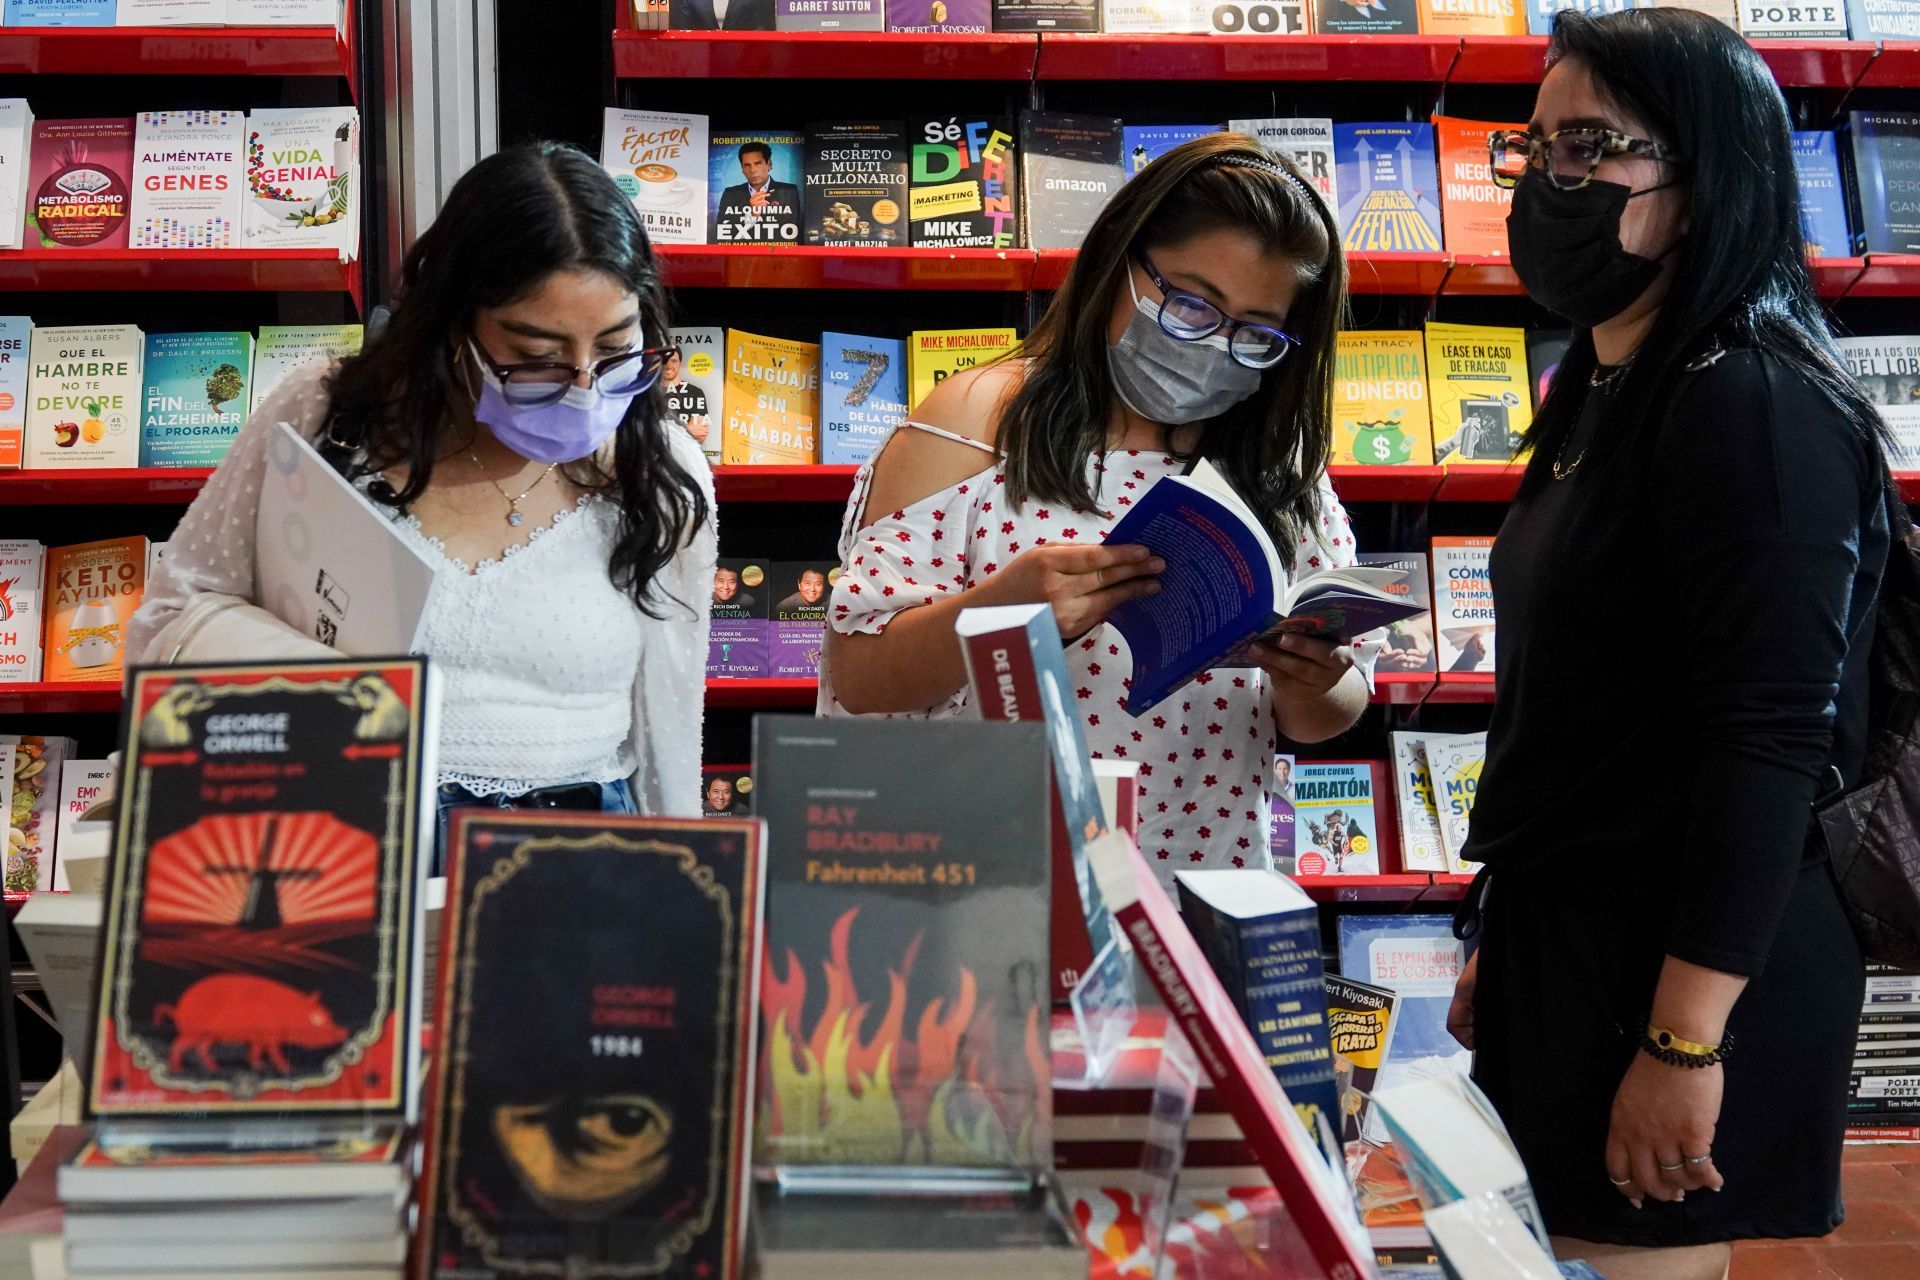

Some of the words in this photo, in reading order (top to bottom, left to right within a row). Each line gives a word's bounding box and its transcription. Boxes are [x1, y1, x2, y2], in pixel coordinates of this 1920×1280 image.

[789, 1, 828, 12] GARRET
[831, 0, 871, 11] SUTTON
[1432, 0, 1514, 17] VENTAS
[1750, 7, 1836, 23] PORTE
[891, 25, 929, 33] ROBERT
[942, 25, 986, 33] KIYOSAKI
[1864, 117, 1908, 125] MICHAEL
[625, 125, 638, 133] EL
[924, 116, 961, 143] Sé
[1257, 126, 1289, 136] VÍCTOR
[1290, 127, 1327, 136] GORDOA
[146, 134, 198, 142] ALEJANDRA
[201, 133, 232, 141] PONCE
[285, 139, 311, 148] UNA
[621, 126, 690, 151] FACTOR
[713, 137, 751, 145] ROBERTO
[142, 149, 233, 163] ALIMÉNTATE
[272, 149, 323, 166] VIDA
[629, 143, 681, 165] LATTE
[820, 149, 892, 161] SECRETO
[167, 163, 191, 171] SEGÚN
[261, 165, 340, 184] GENIAL
[831, 161, 882, 173] MULTI
[144, 174, 229, 192] GENES
[806, 173, 907, 185] MILLONARIO
[1045, 178, 1107, 193] amazon
[38, 194, 123, 205] METABOLISMO
[1361, 197, 1416, 210] LIDERAZGO
[38, 204, 124, 219] RADICAL
[725, 205, 792, 216] ALQUIMIA
[659, 215, 692, 228] BACH
[740, 215, 763, 223] PARA
[716, 217, 799, 240] ÉXITO
[923, 221, 972, 236] MIKE
[1344, 211, 1441, 251] EFECTIVO
[913, 235, 994, 249] MICHALOWICZ
[47, 335, 79, 343] SUSAN
[83, 334, 120, 342] ALBERS
[920, 336, 944, 349] MIKE
[946, 334, 1010, 348] MICHALOWICZ
[1373, 340, 1414, 348] TRACY
[59, 350, 86, 358] QUE
[92, 349, 106, 357] EL
[1441, 343, 1471, 358] LÉASE
[1472, 345, 1485, 358] EN
[1487, 346, 1512, 359] CASO
[1844, 347, 1871, 359] MIRA
[1874, 347, 1881, 358] A
[1884, 347, 1903, 357] LOS
[956, 357, 976, 367] UN
[1450, 360, 1462, 373] DE
[1464, 360, 1507, 374] FRACASO
[1849, 358, 1877, 377] DEL
[36, 362, 128, 378] HAMBRE
[732, 359, 818, 391] LENGUAJE
[830, 371, 849, 381] LOS
[842, 349, 890, 406] 7
[61, 382, 79, 390] NO
[86, 381, 100, 389] TE
[148, 387, 162, 395] EL
[1346, 381, 1423, 401] DINERO
[36, 395, 123, 411] DEVORE
[147, 396, 182, 412] FIN
[184, 401, 207, 411] DEL
[667, 397, 705, 410] QUE
[757, 395, 788, 413] SIN
[146, 412, 241, 427] ALZHEIMER
[849, 411, 864, 421] DE
[866, 413, 881, 423] LA
[145, 428, 161, 438] EL
[165, 426, 239, 438] PROGRAMA
[729, 417, 815, 451] PALABRAS
[75, 557, 111, 569] PODER
[56, 562, 137, 590] KETO
[55, 581, 136, 605] AYUNO
[1450, 591, 1466, 599] UN
[715, 610, 751, 618] VENTAJA
[780, 612, 789, 620] EL
[992, 648, 1011, 673] DE
[205, 712, 290, 734] GEORGE
[203, 733, 290, 754] ORWELL
[1304, 768, 1325, 777] JORGE
[1327, 767, 1355, 776] CUEVAS
[1295, 777, 1370, 800] MARATÓN
[806, 805, 858, 825] RAY
[806, 830, 942, 852] BRADBURY
[806, 860, 927, 885] Fahrenheit
[931, 863, 977, 886] 451
[1376, 952, 1387, 964] EL
[1392, 951, 1458, 965] EXPLICADOR
[1376, 967, 1399, 979] DE
[1403, 965, 1460, 979] COSAS
[1342, 986, 1384, 1010] Kiyosaki
[1328, 1012, 1367, 1027] ESCAPA
[1330, 1022, 1374, 1039] CARRERA
[590, 1035, 643, 1057] 1984
[1338, 1034, 1377, 1051] RATA
[1883, 1088, 1918, 1096] PORTE
